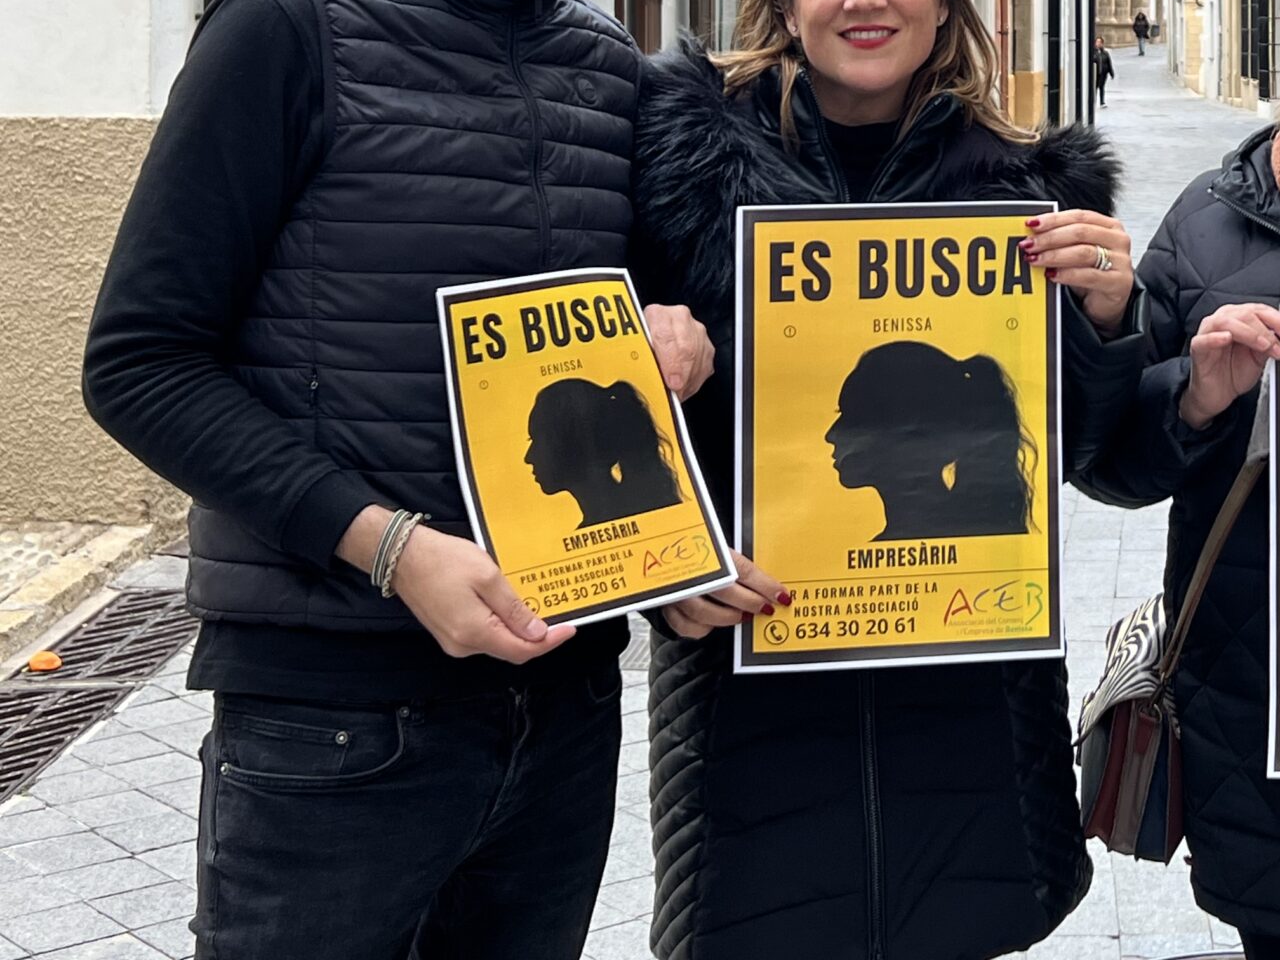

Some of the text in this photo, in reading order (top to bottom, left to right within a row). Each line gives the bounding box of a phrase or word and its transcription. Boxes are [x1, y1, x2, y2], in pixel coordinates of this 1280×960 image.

[769, 235, 1033, 303] ES BUSCA
[461, 294, 639, 365] ES BUSCA
[873, 317, 933, 333] BENISSA
[540, 359, 583, 376] BENISSA
[563, 522, 640, 552] EMPRESÀRIA
[520, 549, 634, 585] PER A FORMAR PART DE LA
[642, 535, 711, 579] ACEB
[847, 542, 958, 570] EMPRESÀRIA
[538, 564, 625, 593] NOSTRA ASSOCIACIÓ
[543, 576, 627, 608] 634 30 20 61
[802, 590, 810, 600] A
[815, 586, 864, 599] FORMAR
[870, 584, 900, 596] PART
[905, 583, 920, 594] DE
[925, 581, 938, 593] LA
[794, 600, 919, 618] NOSTRA ASSOCIACIÓ
[944, 579, 1043, 627] ACEB
[795, 616, 917, 639] 634 30 20 61
